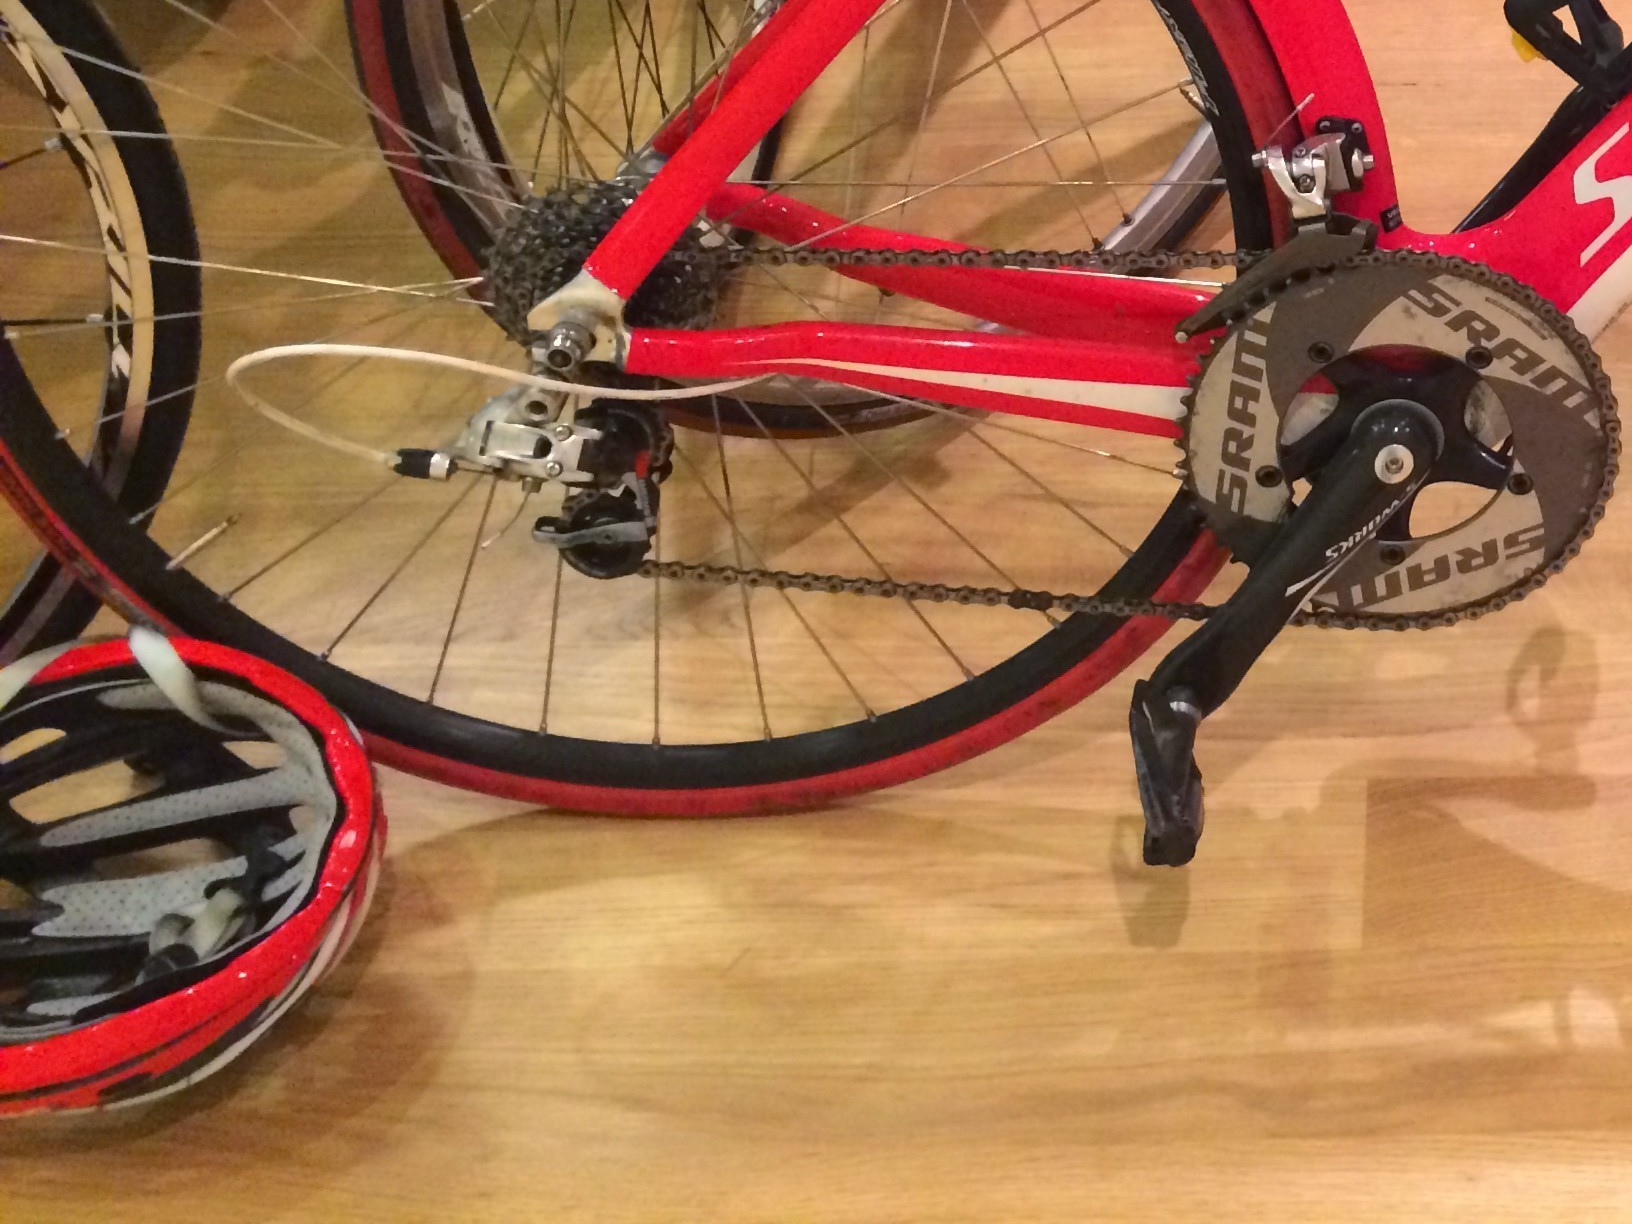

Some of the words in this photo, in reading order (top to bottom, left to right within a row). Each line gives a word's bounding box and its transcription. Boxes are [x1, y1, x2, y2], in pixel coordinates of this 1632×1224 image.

[1216, 309, 1276, 515] SRAM
[1404, 283, 1603, 426] SRAM
[1317, 522, 1546, 612] SRAM
